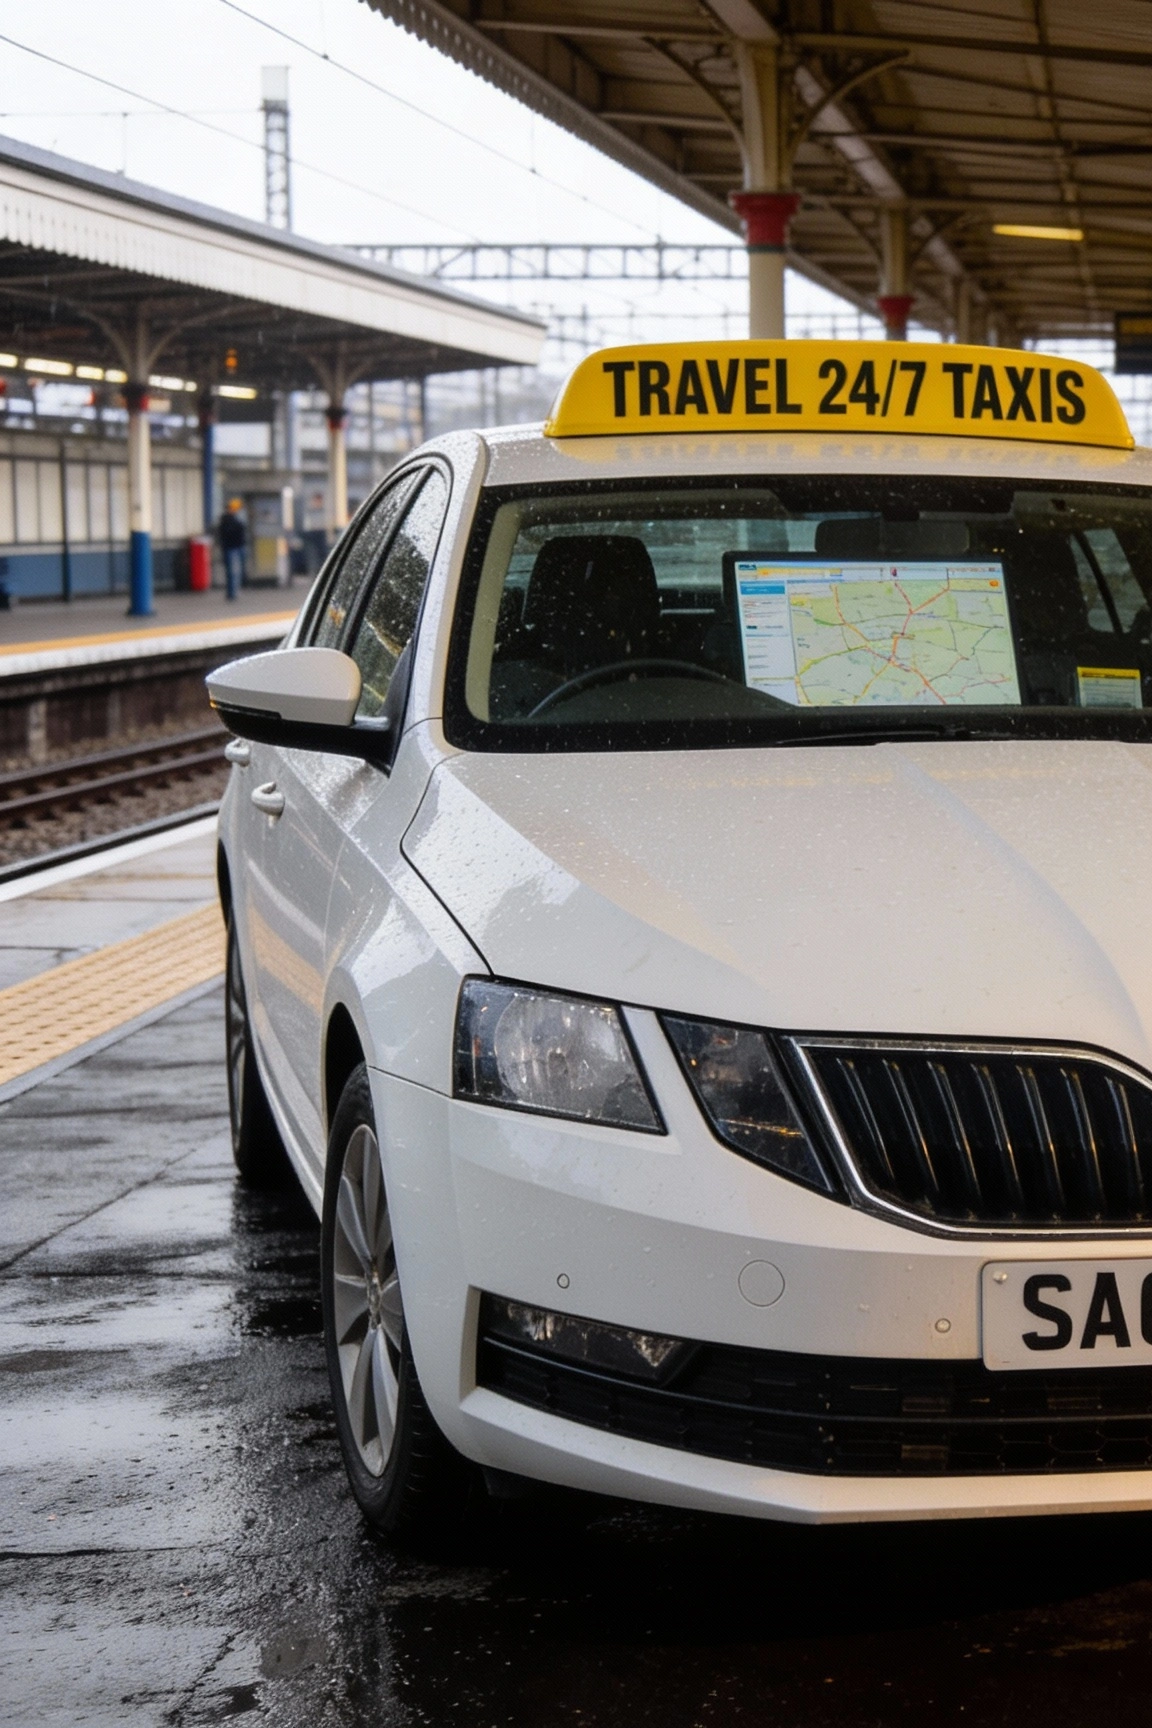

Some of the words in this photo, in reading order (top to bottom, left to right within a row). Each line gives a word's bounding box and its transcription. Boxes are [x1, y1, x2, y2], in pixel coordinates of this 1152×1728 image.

[602, 358, 803, 418] TRAVEL
[818, 358, 928, 418] 24/7
[941, 362, 1087, 426] TAXIS
